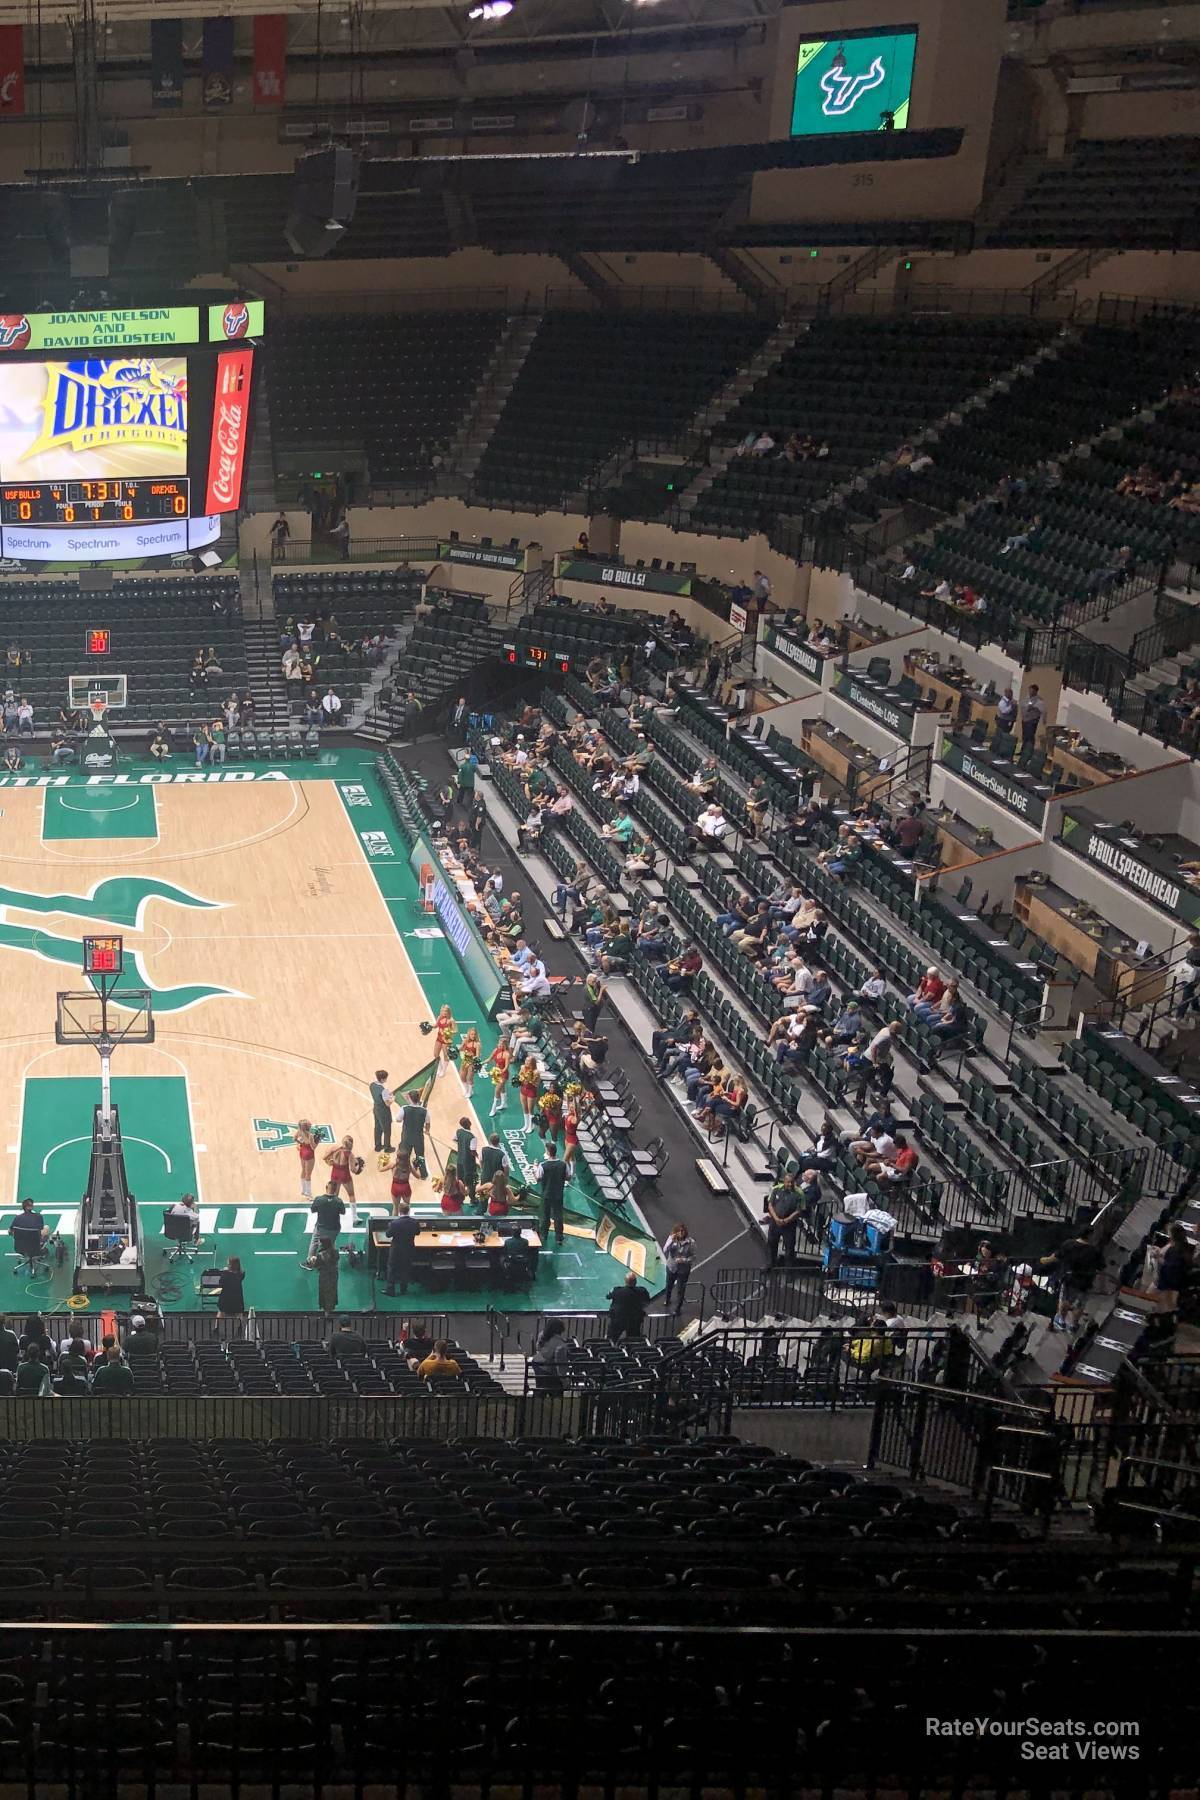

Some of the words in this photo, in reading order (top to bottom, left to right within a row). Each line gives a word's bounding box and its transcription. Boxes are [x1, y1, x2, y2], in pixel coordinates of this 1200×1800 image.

[852, 173, 874, 187] 315
[48, 312, 108, 325] JOANNE
[111, 310, 170, 322] NELSON
[92, 323, 125, 334] AND
[43, 336, 89, 347] DAVID
[92, 332, 175, 344] GOLDSTEIN
[53, 490, 61, 500] 4
[81, 482, 119, 500] 7:31
[127, 488, 136, 498] 4
[151, 485, 178, 495] DREXEL
[19, 502, 31, 520] 0
[174, 496, 186, 514] 0
[65, 508, 74, 522] 0
[124, 506, 133, 520] 0
[7, 536, 49, 550] Spectrum
[67, 538, 118, 551] Spectrum
[136, 532, 181, 546] Spectrum
[601, 568, 614, 581] GO
[614, 570, 646, 586] BULLS!
[91, 639, 105, 652] 30
[883, 709, 899, 728] LOGE
[86, 770, 291, 786] FLORIDA
[970, 763, 1007, 797] CenterState
[1007, 786, 1028, 813] LOGE
[1087, 834, 1180, 910] #BULLSPEEDAHEAD
